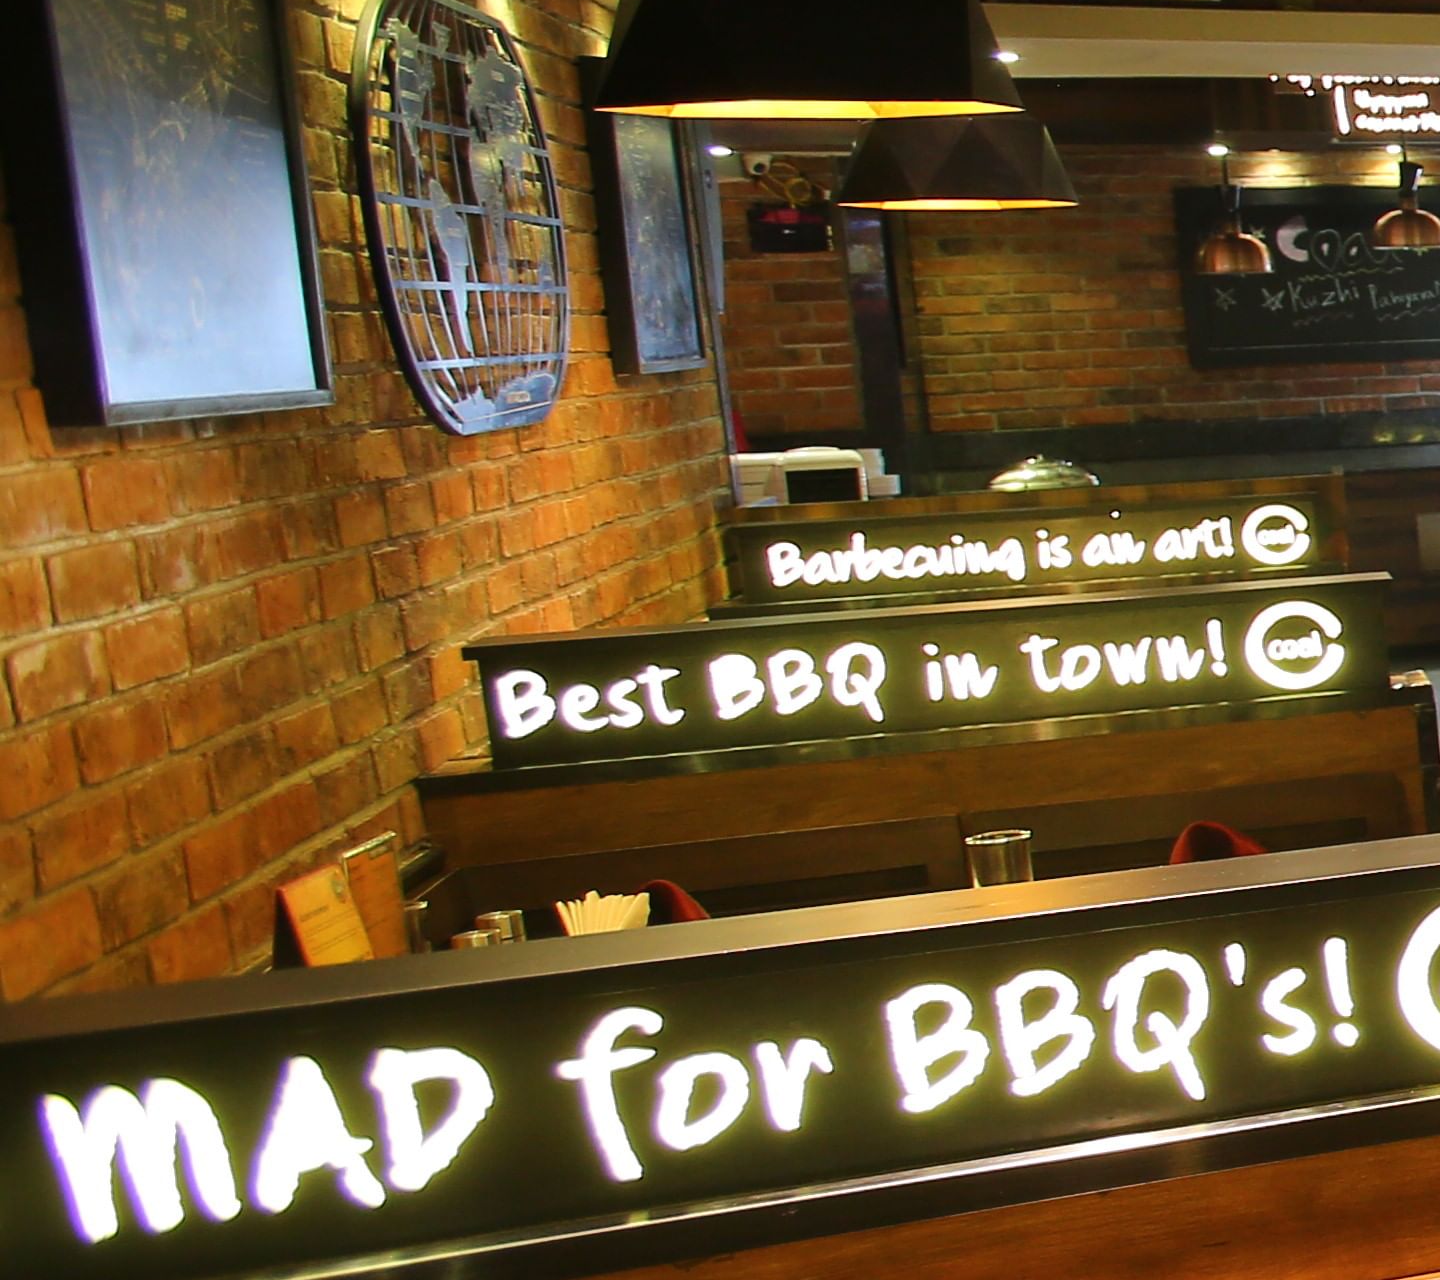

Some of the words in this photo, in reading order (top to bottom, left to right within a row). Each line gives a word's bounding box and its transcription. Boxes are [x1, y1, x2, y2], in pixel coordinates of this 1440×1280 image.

[767, 532, 1026, 587] Barbecuing
[1036, 530, 1072, 569] is
[1082, 532, 1145, 567] an
[1152, 516, 1235, 562] art!
[496, 665, 684, 738] Best
[709, 642, 886, 722] BBQ
[923, 644, 998, 701] in
[1020, 619, 1228, 692] town!
[42, 1046, 495, 1244] MAD
[556, 1006, 833, 1182] for
[886, 935, 1360, 1114] BBQ's!
